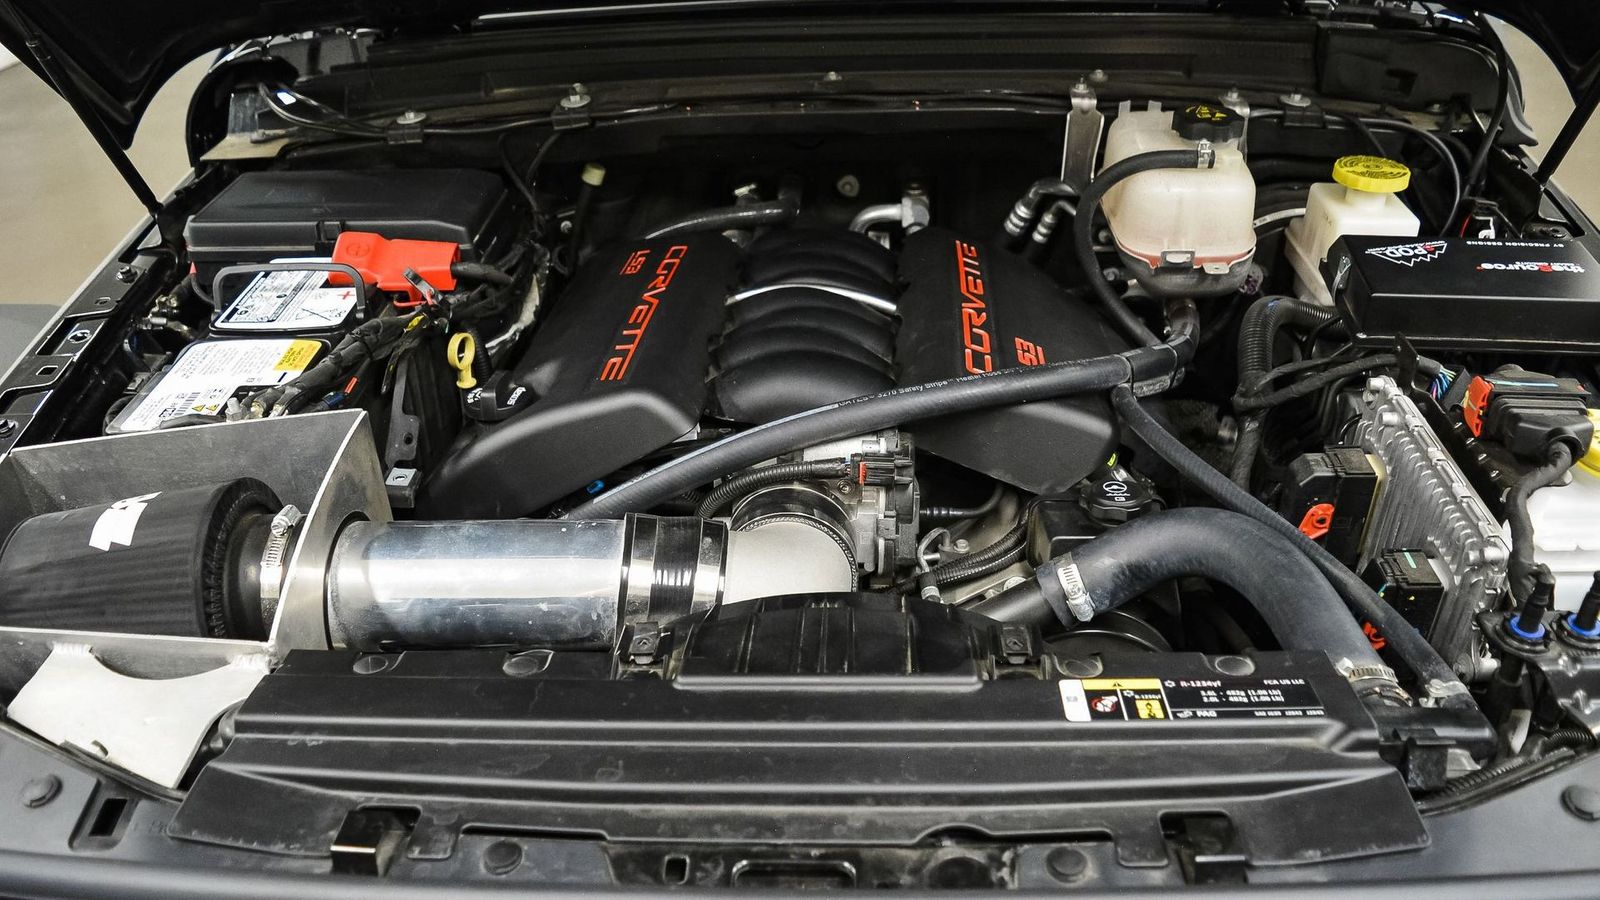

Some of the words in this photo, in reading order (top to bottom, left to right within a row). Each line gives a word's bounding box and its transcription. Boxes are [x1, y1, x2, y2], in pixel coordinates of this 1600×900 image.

[600, 245, 688, 381] CORVETTE
[955, 239, 993, 374] CORVETTE
[898, 384, 923, 394] Safety
